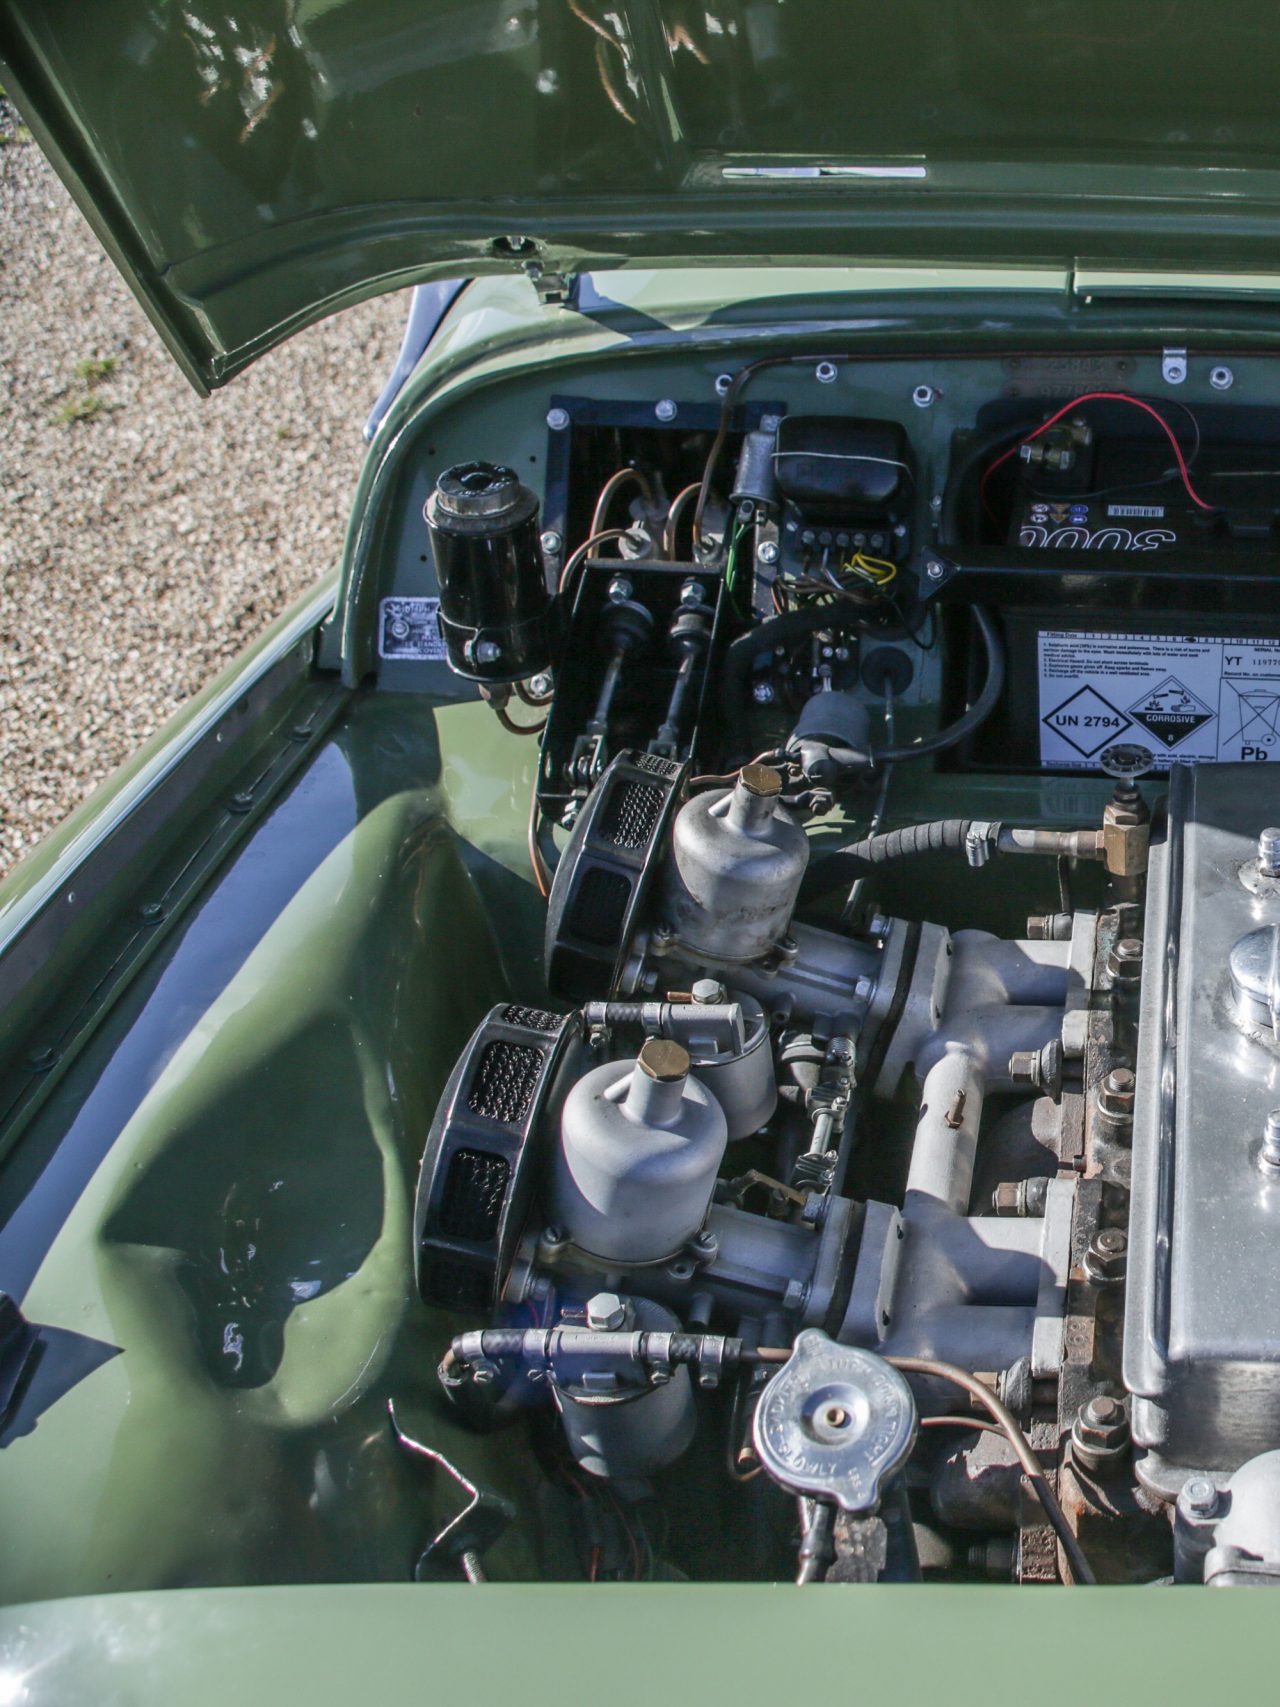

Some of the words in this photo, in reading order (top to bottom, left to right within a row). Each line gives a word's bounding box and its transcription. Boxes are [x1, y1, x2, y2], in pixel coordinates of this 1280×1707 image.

[1225, 656, 1242, 666] YT
[1056, 714, 1078, 726] UN
[1084, 716, 1120, 728] 2794
[1146, 714, 1196, 724] CORROSIVE
[1168, 734, 1174, 742] 8
[1241, 746, 1268, 760] Pb
[778, 1444, 837, 1474] SLOWLY
